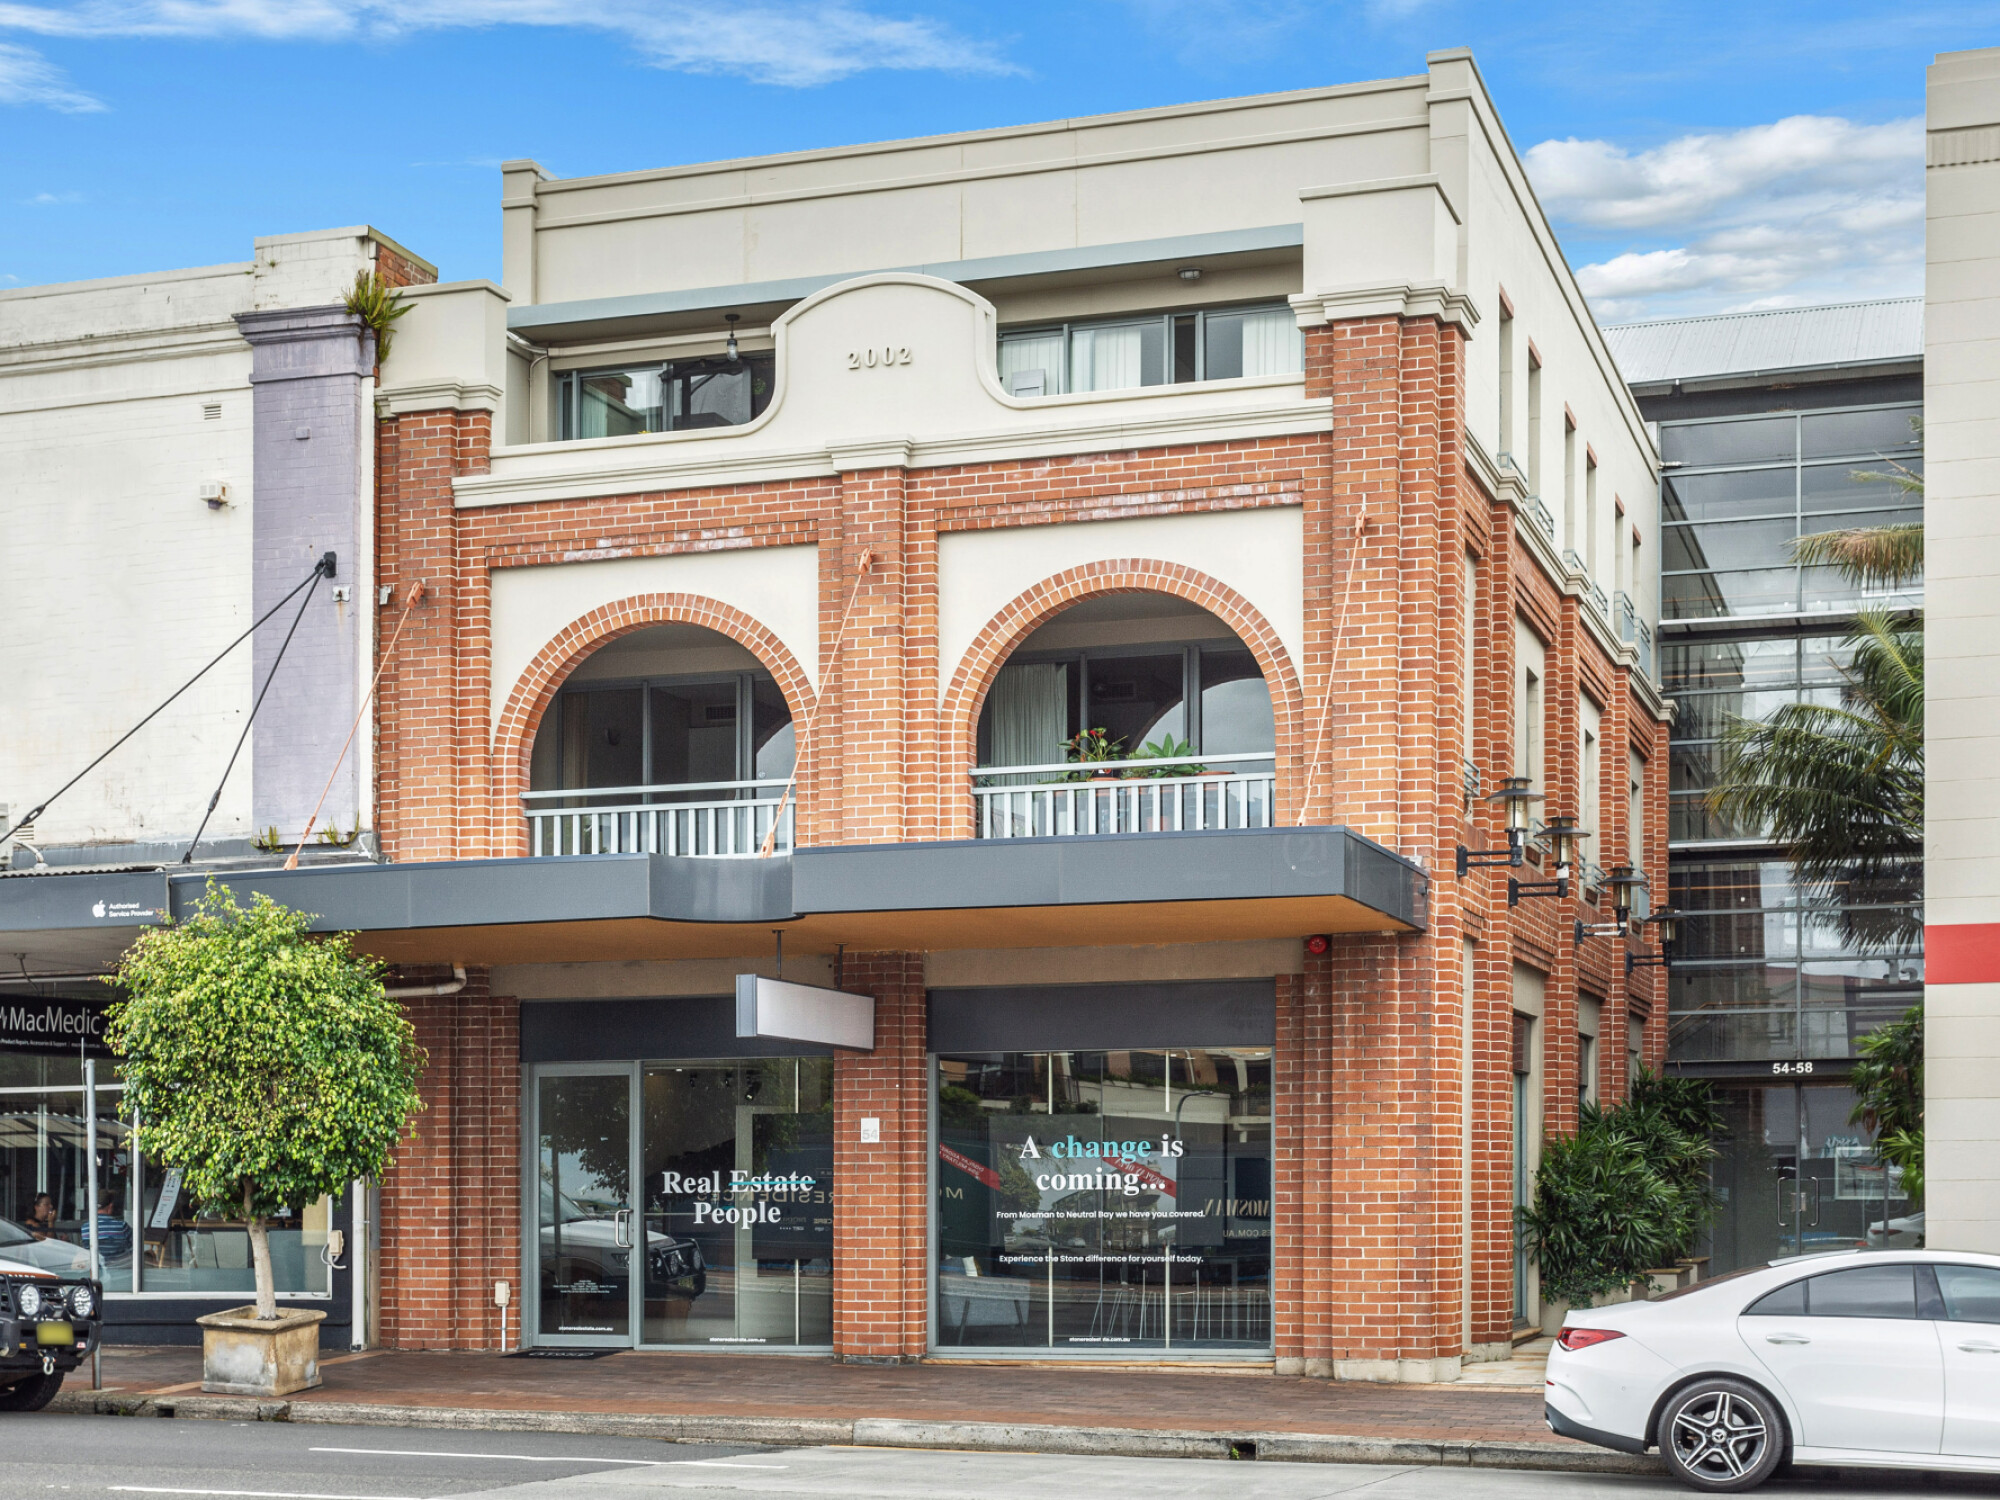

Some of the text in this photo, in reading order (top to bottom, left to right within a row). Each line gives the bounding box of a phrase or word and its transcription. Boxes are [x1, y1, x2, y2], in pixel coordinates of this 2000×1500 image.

[847, 345, 913, 371] 2002
[108, 902, 140, 910] Authorised
[108, 909, 154, 918] Service Provider
[9, 1005, 100, 1035] MacMedic
[1772, 1061, 1813, 1074] 54-58
[862, 1129, 879, 1140] 54
[1018, 1133, 1184, 1164] A change is
[661, 1169, 815, 1194] Real Estate
[1036, 1166, 1166, 1196] coming...
[692, 1201, 781, 1230] People
[996, 1211, 1018, 1219] From
[1019, 1211, 1055, 1219] Mosman
[1056, 1211, 1065, 1219] to
[1066, 1210, 1097, 1219] Neutral
[1098, 1210, 1114, 1220] Bay
[1129, 1210, 1150, 1218] have
[1151, 1211, 1168, 1220] you
[1168, 1209, 1205, 1218] covered.
[999, 1254, 1044, 1264] Experience
[1085, 1254, 1127, 1263] difference
[1128, 1254, 1140, 1262] for
[1141, 1254, 1175, 1264] yourself
[1176, 1254, 1204, 1264] today.
